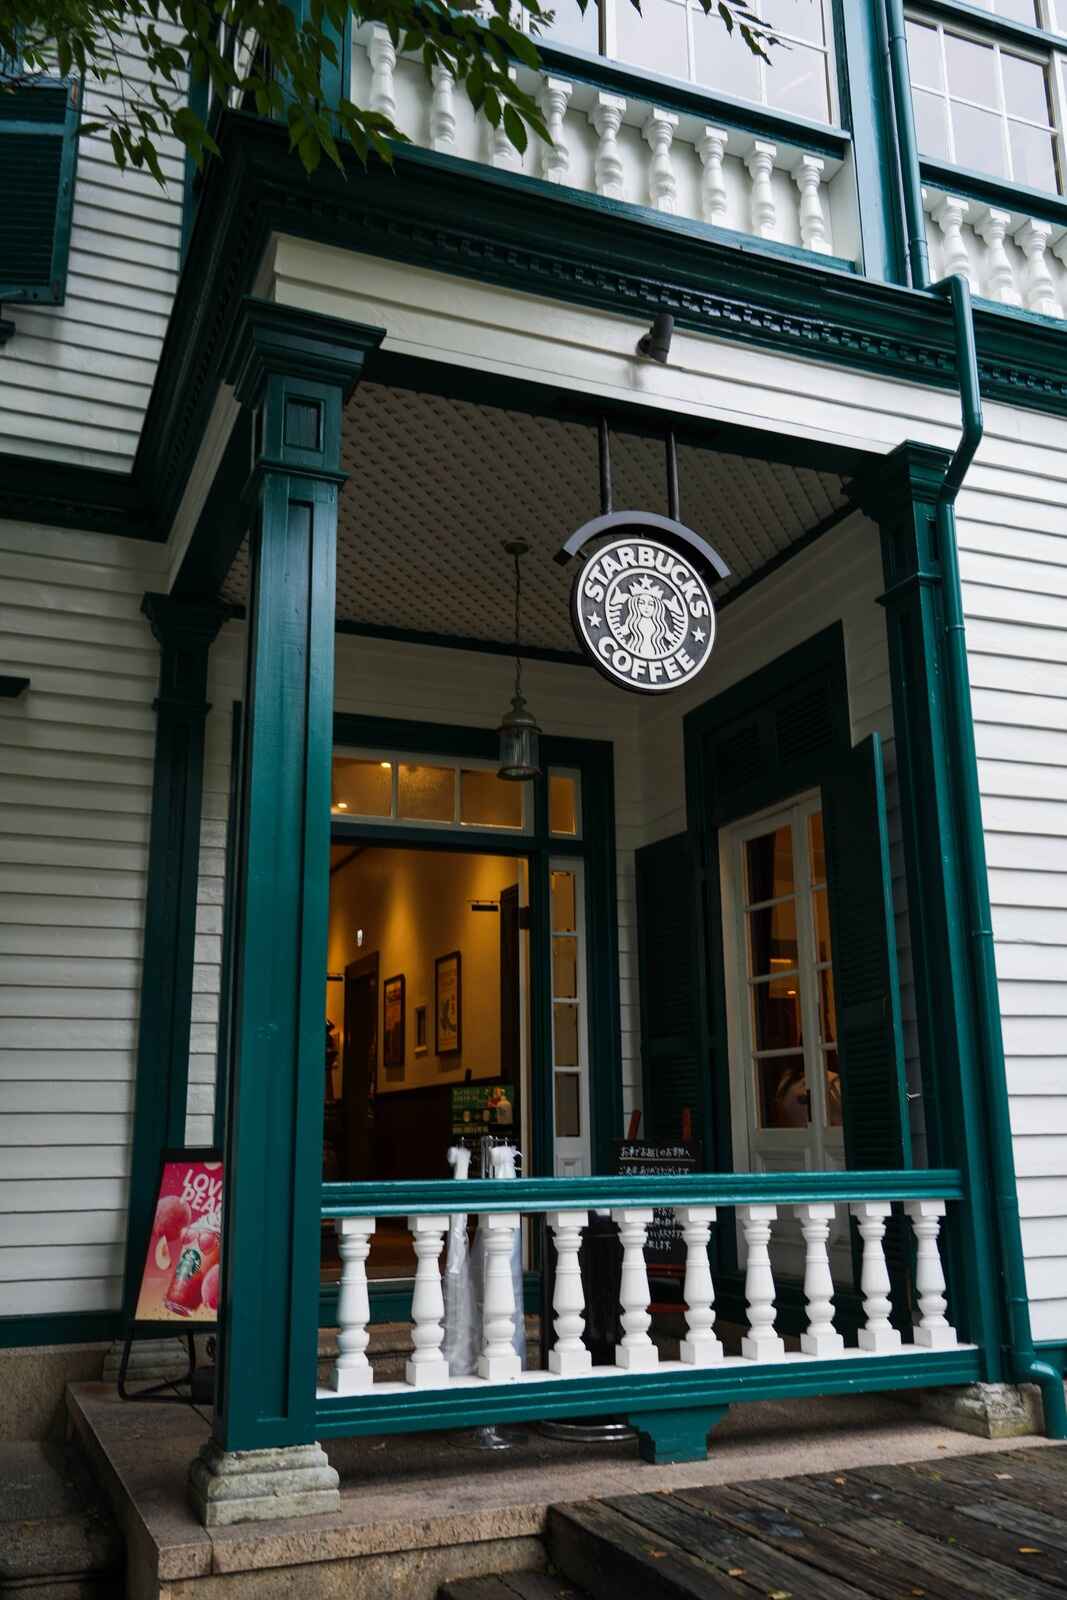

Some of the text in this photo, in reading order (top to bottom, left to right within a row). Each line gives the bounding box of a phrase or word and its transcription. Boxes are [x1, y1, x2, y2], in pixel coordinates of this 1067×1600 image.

[584, 546, 708, 618] STARBUCKS
[598, 636, 696, 682] COFFEE
[179, 1187, 223, 1213] PEA
[183, 1168, 223, 1200] LOV
